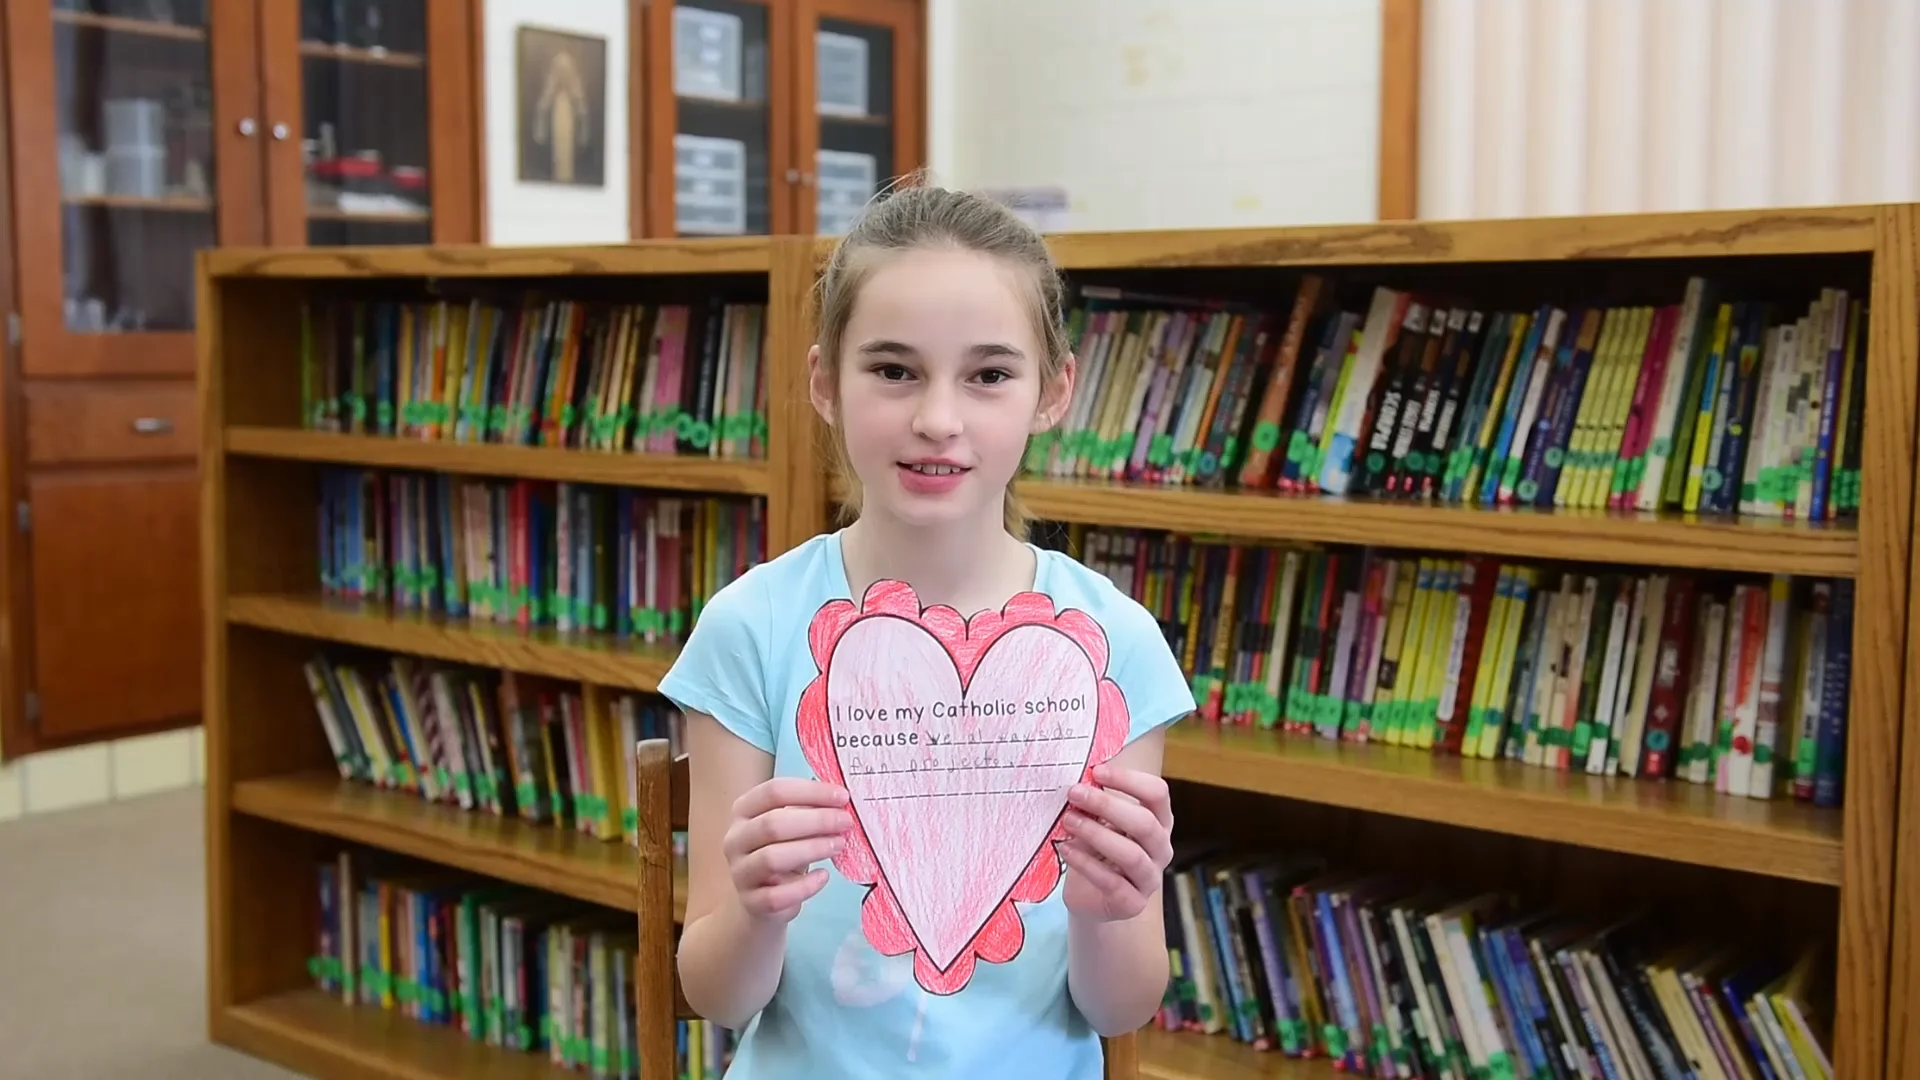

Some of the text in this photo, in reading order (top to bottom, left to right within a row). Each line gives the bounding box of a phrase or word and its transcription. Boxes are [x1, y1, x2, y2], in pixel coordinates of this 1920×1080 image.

[835, 694, 1086, 724] I love my Catholic school
[836, 731, 919, 749] because
[849, 756, 888, 774] fun
